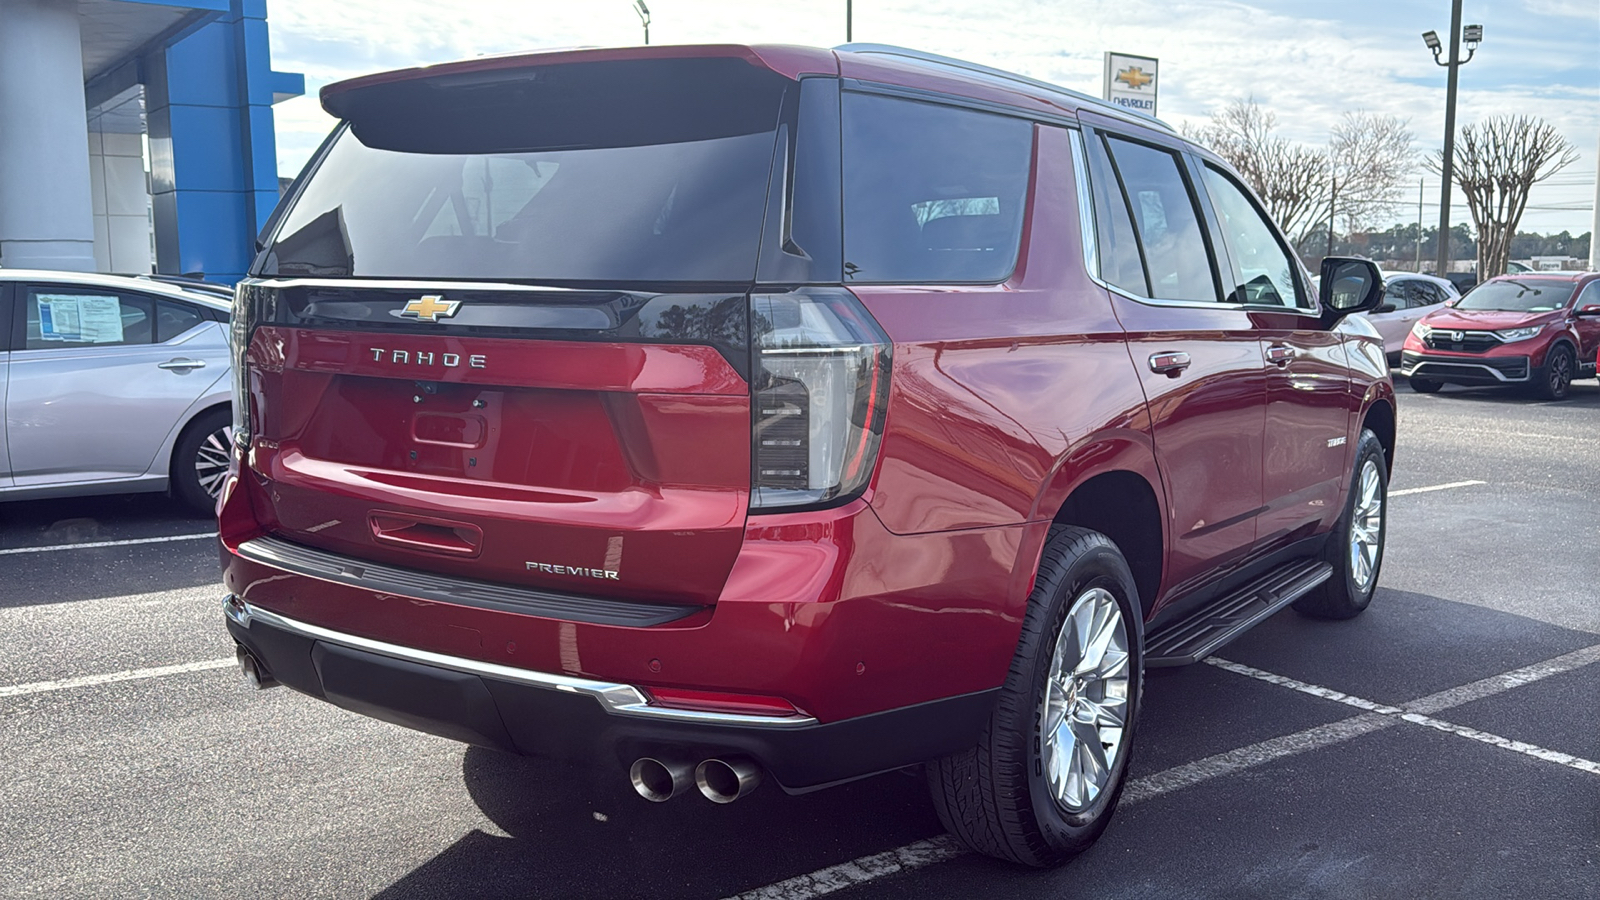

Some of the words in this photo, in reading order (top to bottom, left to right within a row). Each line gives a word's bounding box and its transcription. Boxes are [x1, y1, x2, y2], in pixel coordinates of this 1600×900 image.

[1113, 96, 1154, 110] CHEVROLET
[370, 347, 487, 369] TAHOE
[525, 561, 620, 581] PREMIER
